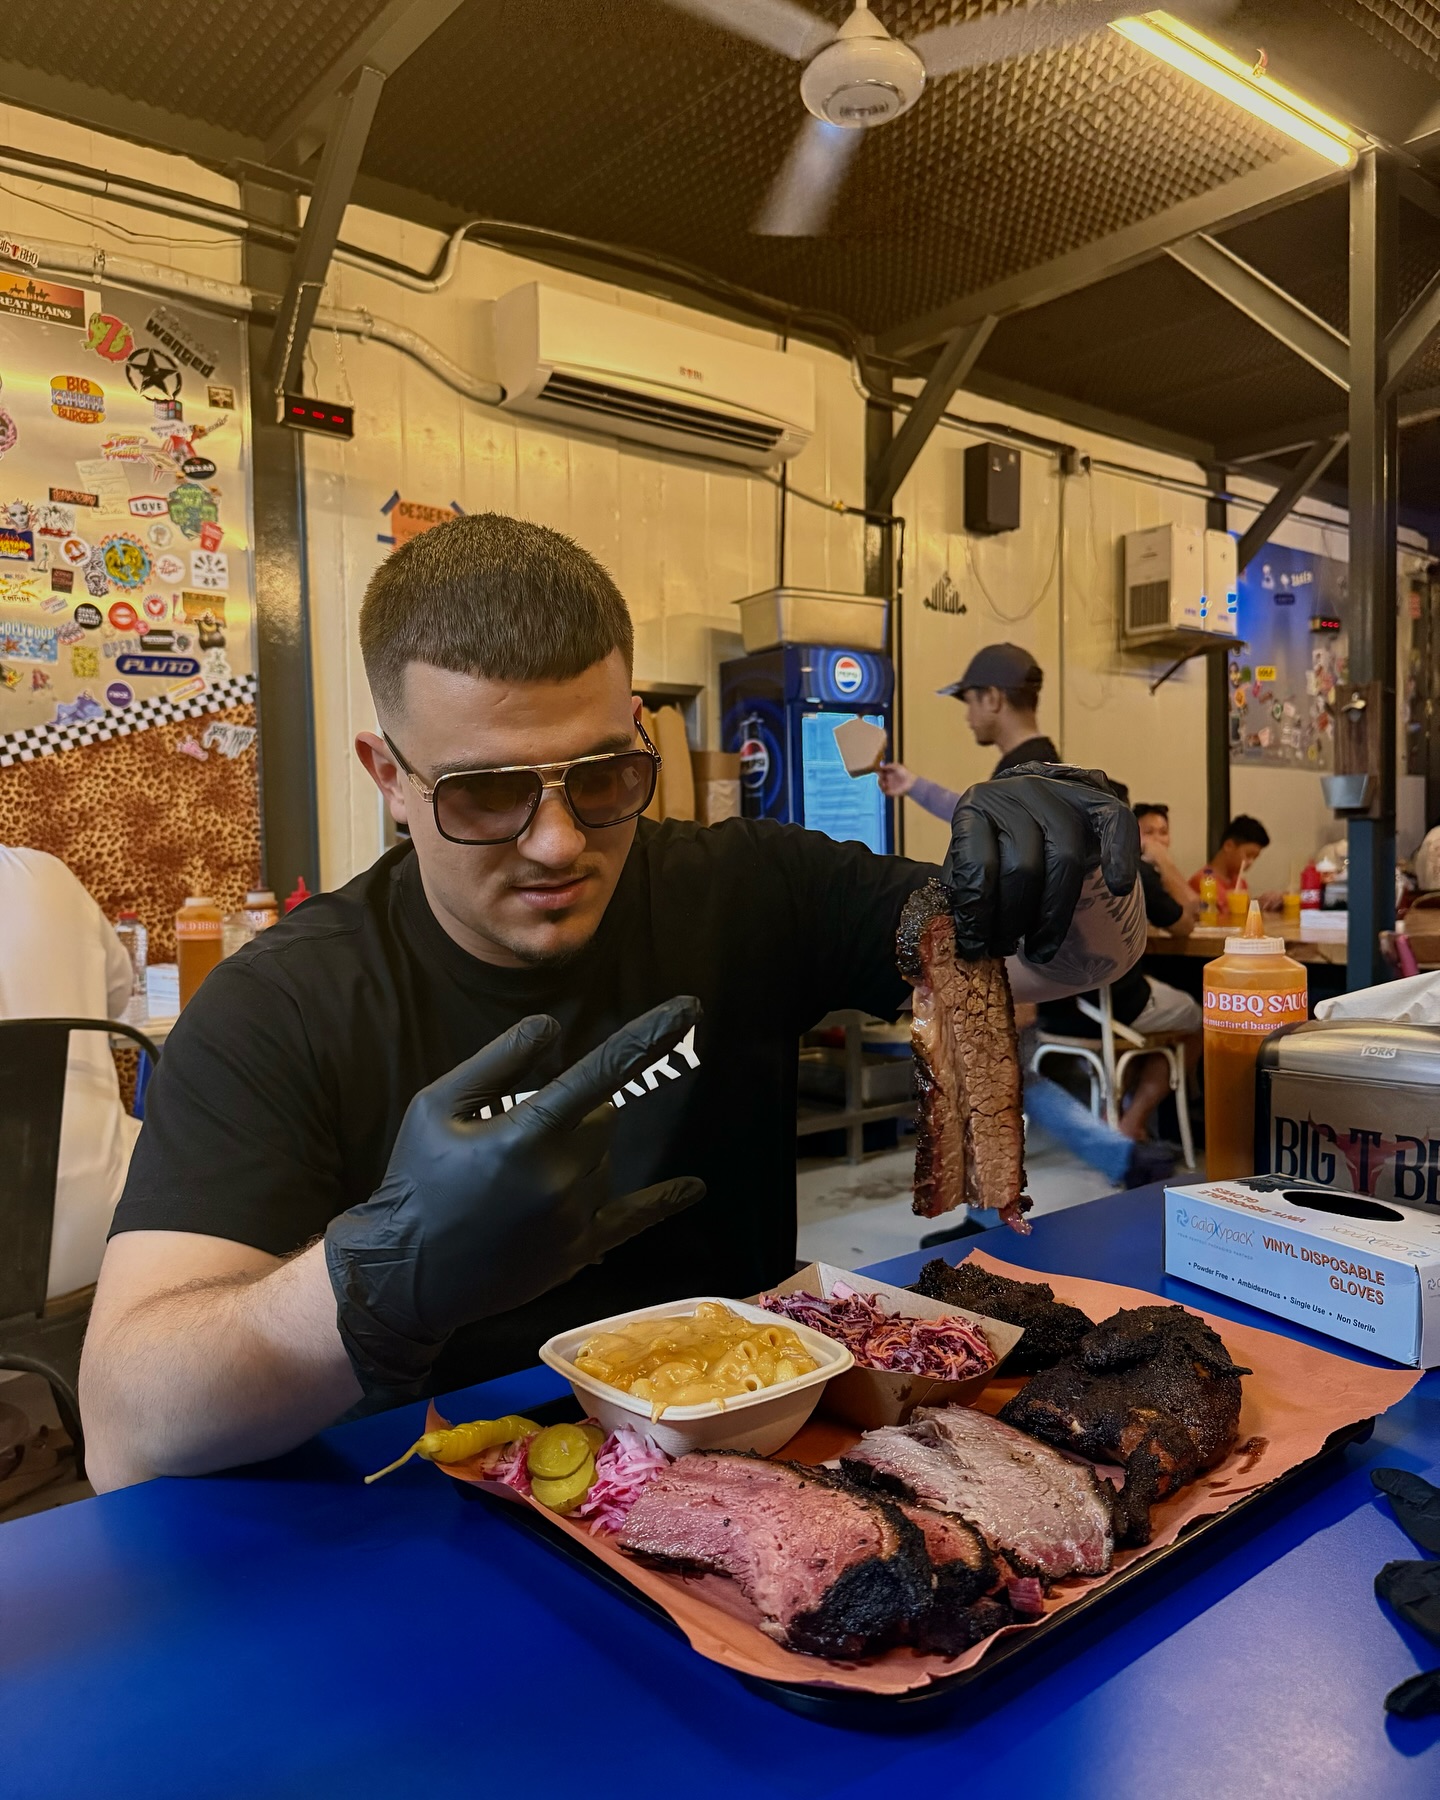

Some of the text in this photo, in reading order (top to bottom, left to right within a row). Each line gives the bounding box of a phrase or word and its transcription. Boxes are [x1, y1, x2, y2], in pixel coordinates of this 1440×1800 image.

[20, 248, 38, 267] BBQ
[31, 301, 72, 319] PLAINS
[66, 376, 90, 394] BIG
[57, 406, 99, 424] BURGER
[135, 502, 163, 512] LOVE
[122, 658, 195, 674] PLUTO
[1219, 993, 1264, 1017] BBQ
[1363, 1045, 1395, 1057] TORK
[1275, 1116, 1337, 1185] BIG
[1349, 1127, 1383, 1192] T
[1262, 1235, 1385, 1286] VINYL DISPOSABLE
[1193, 1261, 1376, 1334] Powder Free Ambidextrous Single Use Non Sterile
[1329, 1275, 1384, 1306] GLOVES
